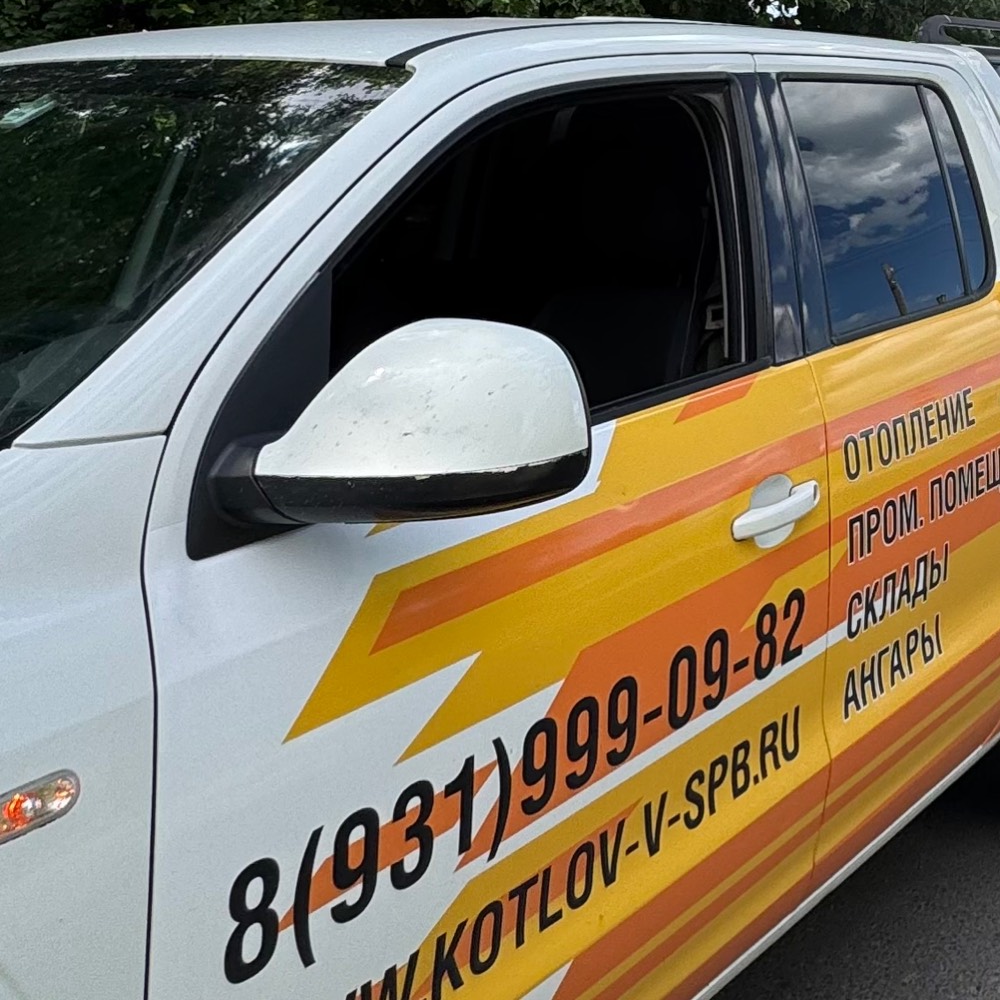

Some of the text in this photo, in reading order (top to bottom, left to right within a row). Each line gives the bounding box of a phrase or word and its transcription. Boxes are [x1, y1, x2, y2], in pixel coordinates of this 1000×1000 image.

[844, 388, 975, 479] ОТОПЛЕНИЕ
[848, 489, 924, 562] ПРОМ.
[847, 543, 949, 638] СКЛАДЫ
[843, 615, 943, 720] АНГАРЫ
[224, 588, 806, 983] 8(931)999-09-82
[346, 706, 800, 1000] WKOTLOV-V-SPB.RU
